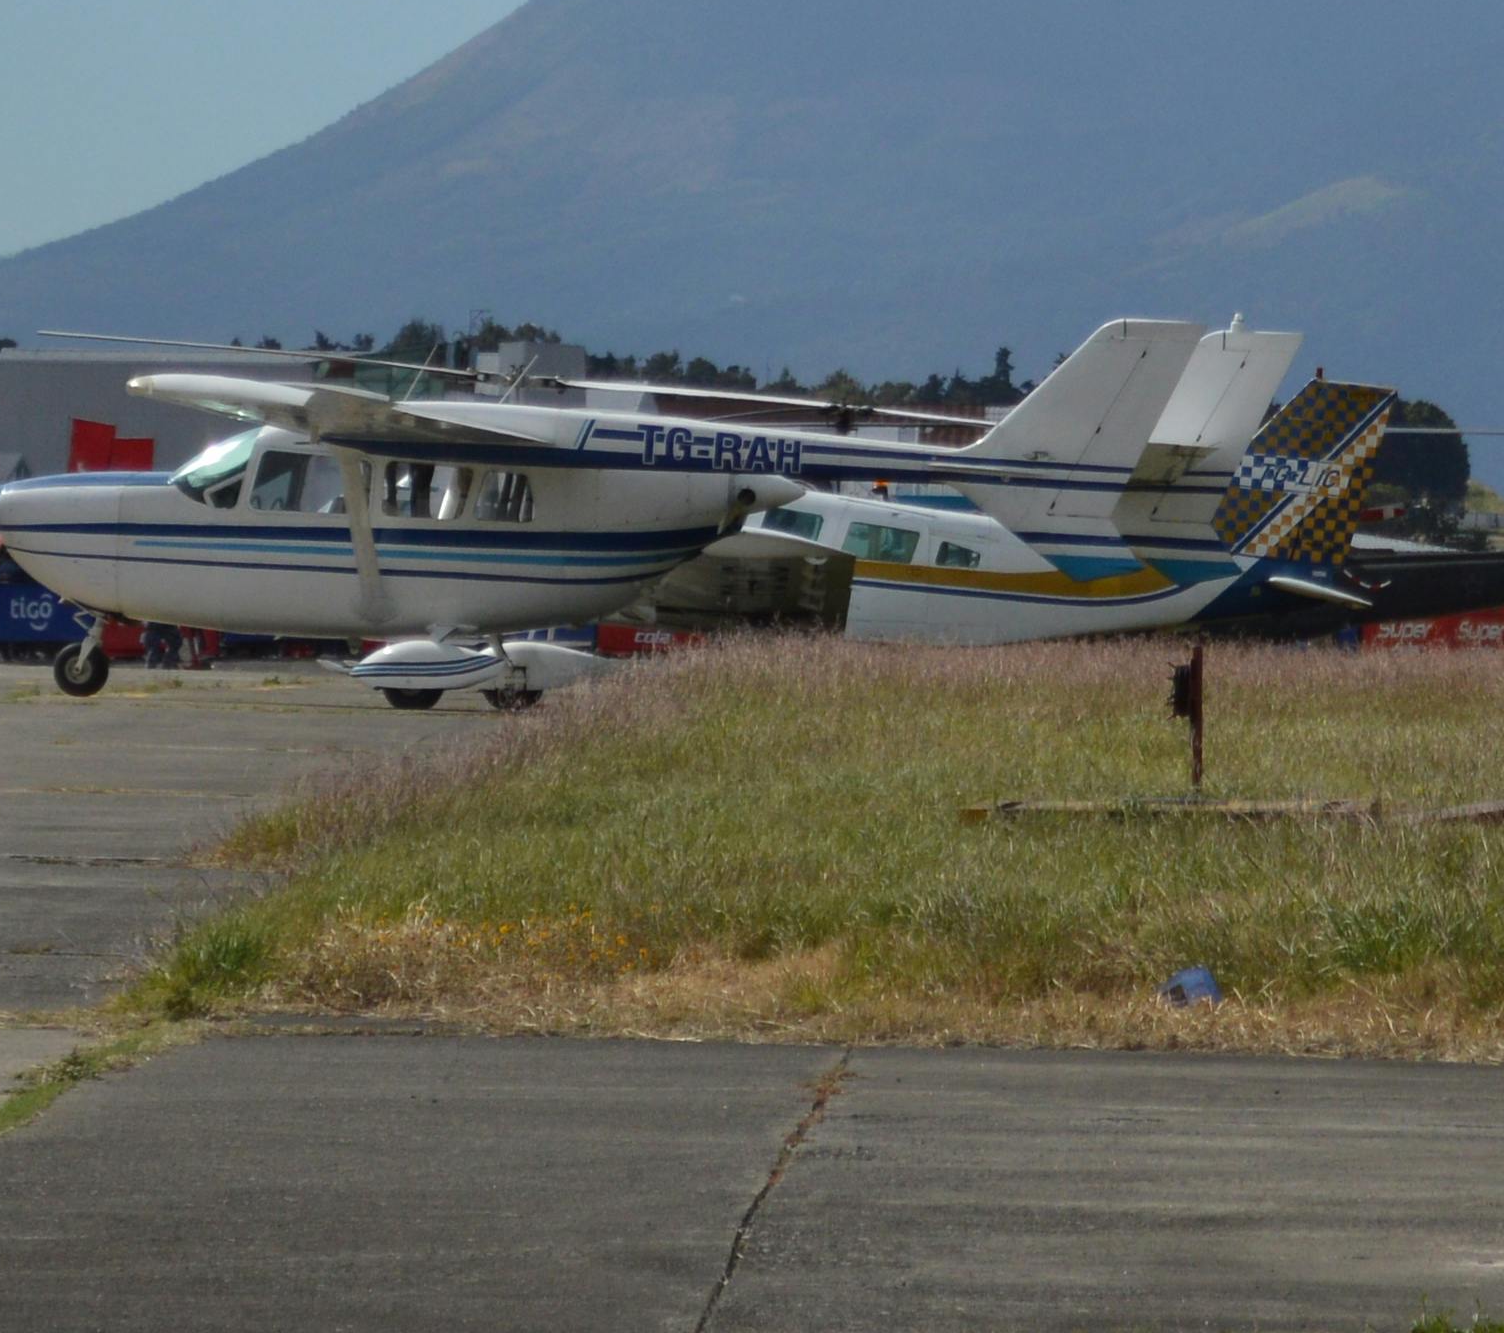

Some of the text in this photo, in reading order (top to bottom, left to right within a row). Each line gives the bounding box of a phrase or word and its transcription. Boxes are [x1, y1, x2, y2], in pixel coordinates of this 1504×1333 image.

[637, 424, 802, 475] TG-RAH
[1261, 463, 1340, 488] TG-LIC
[634, 631, 672, 644] cola
[1378, 623, 1434, 640] Super
